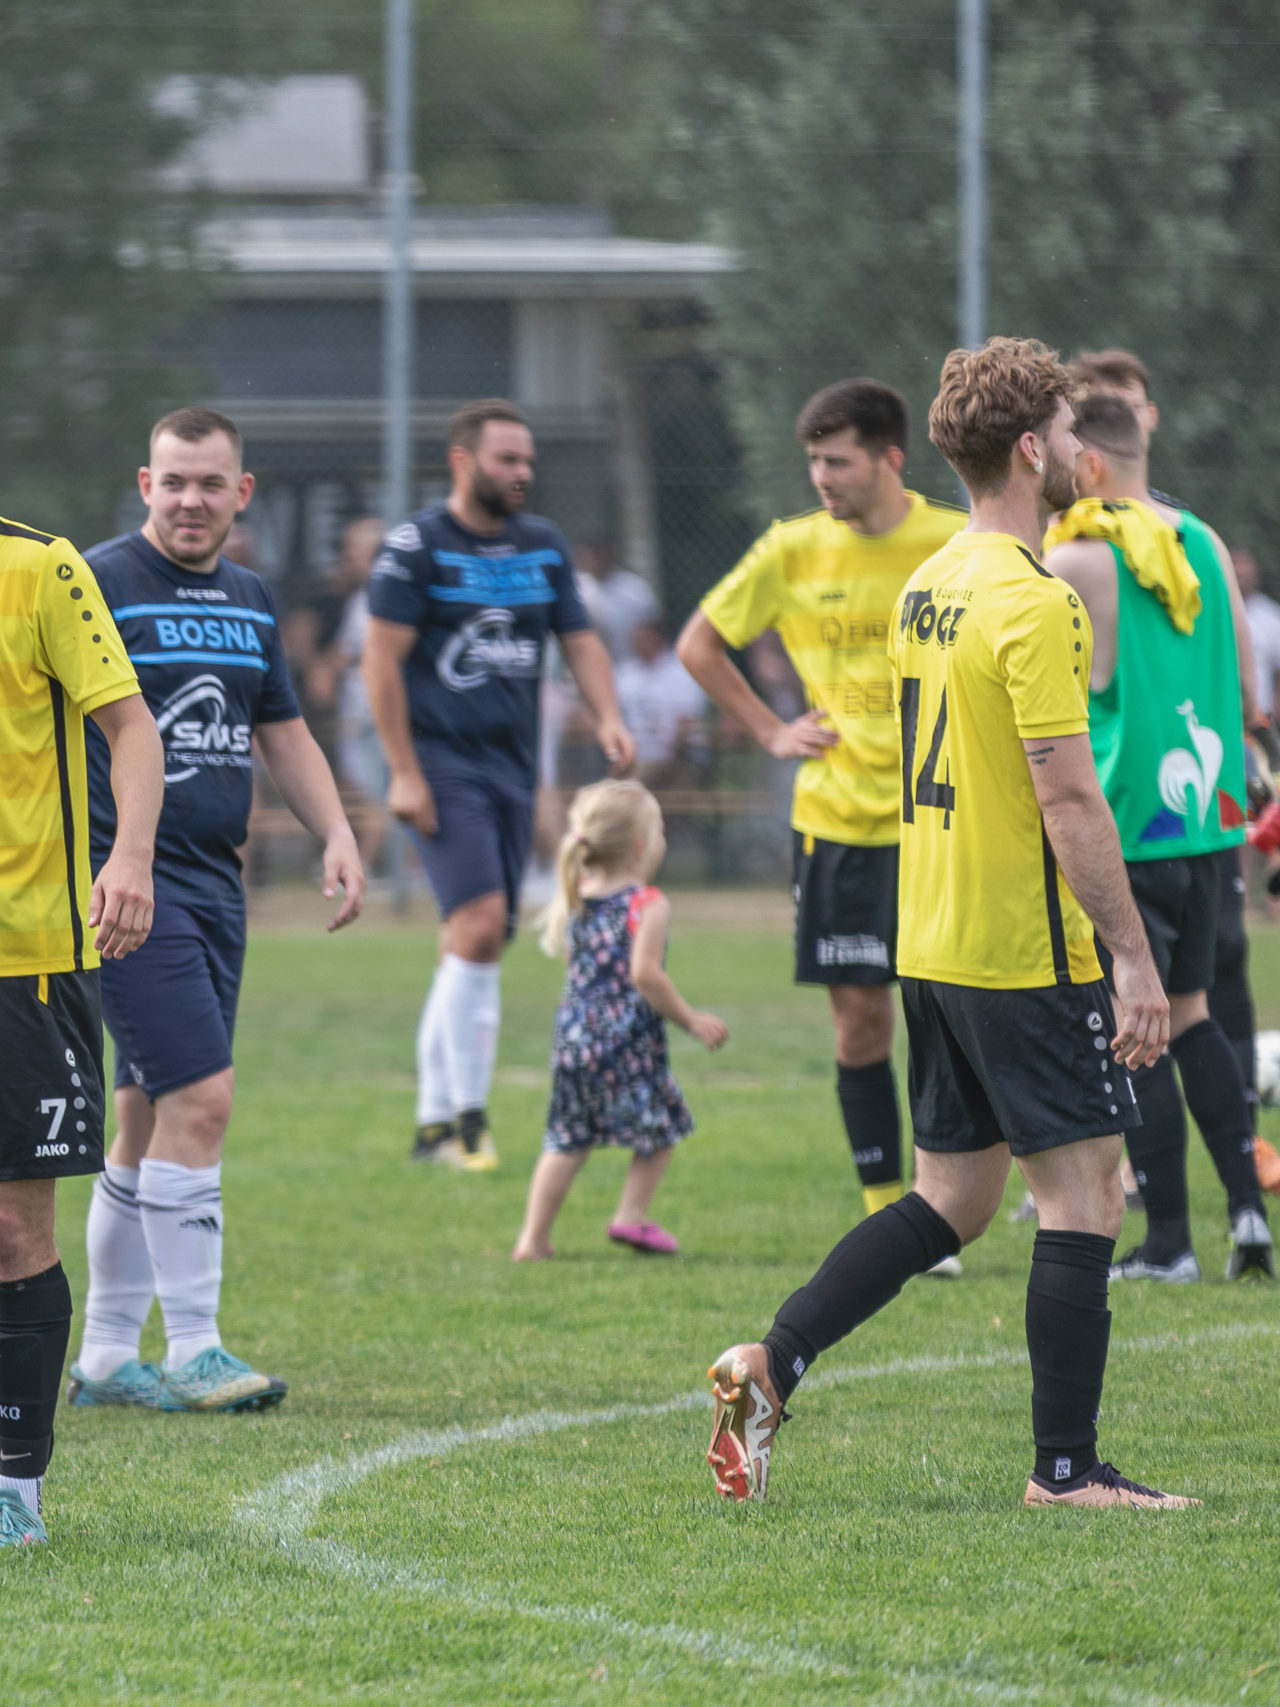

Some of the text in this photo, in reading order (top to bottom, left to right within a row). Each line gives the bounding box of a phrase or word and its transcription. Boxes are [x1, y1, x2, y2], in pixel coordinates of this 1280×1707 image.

[155, 618, 263, 653] BOSNA
[170, 721, 250, 753] SMS
[899, 677, 956, 830] 14
[41, 1098, 67, 1140] 7
[35, 1142, 69, 1158] JAKO
